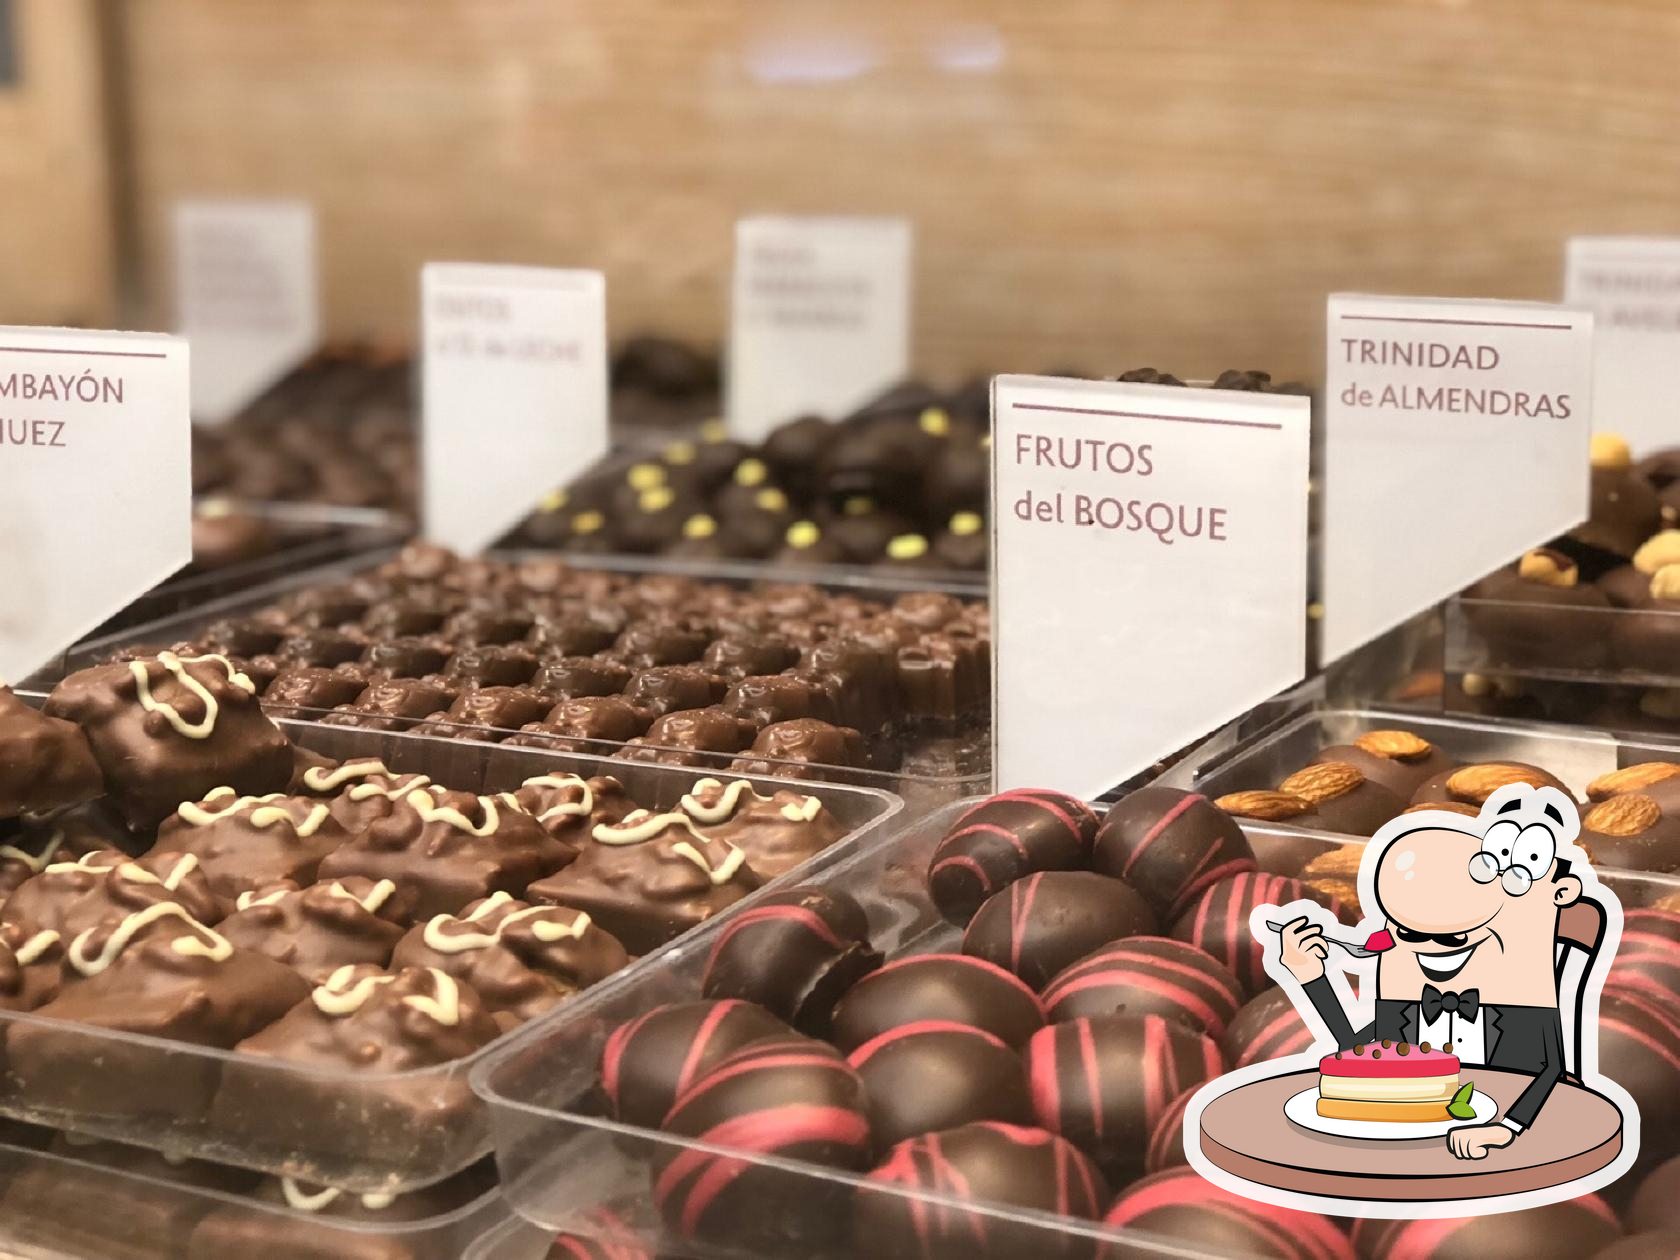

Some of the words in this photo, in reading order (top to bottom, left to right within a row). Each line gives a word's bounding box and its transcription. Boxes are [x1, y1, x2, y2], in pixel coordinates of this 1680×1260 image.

[1341, 338, 1500, 370] TRINIDAD
[1340, 382, 1374, 408] de
[1379, 384, 1572, 420] ALMENDRAS
[0, 418, 67, 447] UEZ
[1016, 433, 1153, 476] FRUTOS
[1014, 490, 1065, 524] del
[1075, 494, 1228, 545] BOSQUE
